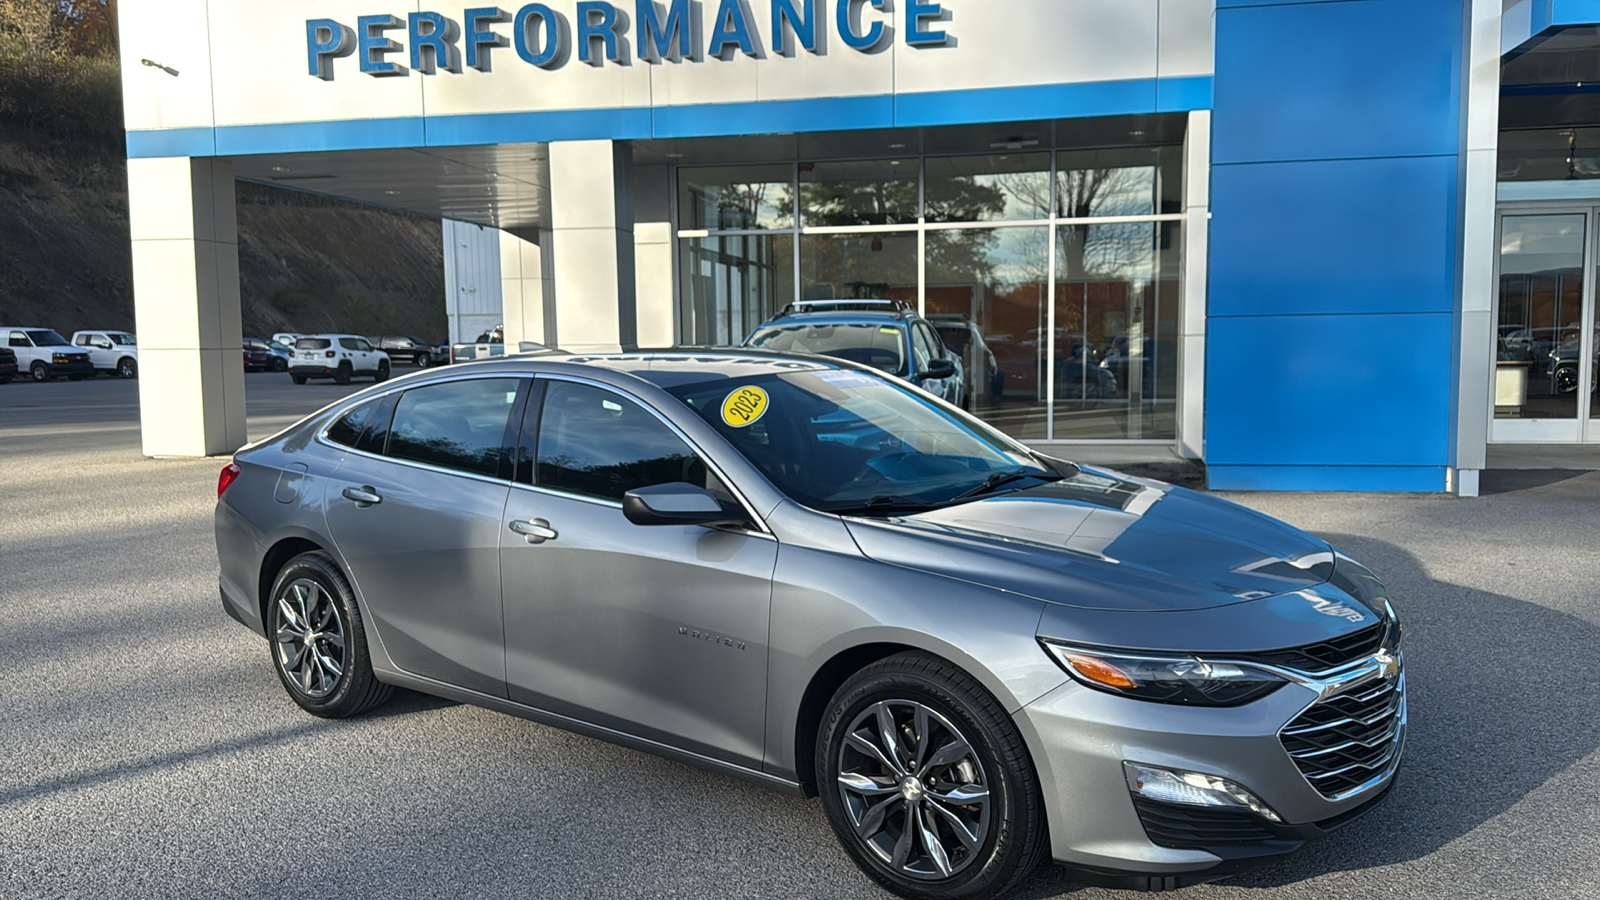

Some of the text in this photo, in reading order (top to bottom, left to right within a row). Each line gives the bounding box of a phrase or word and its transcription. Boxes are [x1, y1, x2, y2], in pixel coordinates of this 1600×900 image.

[306, 0, 953, 80] PERFORMANCE
[729, 389, 762, 421] 2023
[678, 626, 746, 650] MALIBU
[981, 818, 1010, 884] FORTUNE
